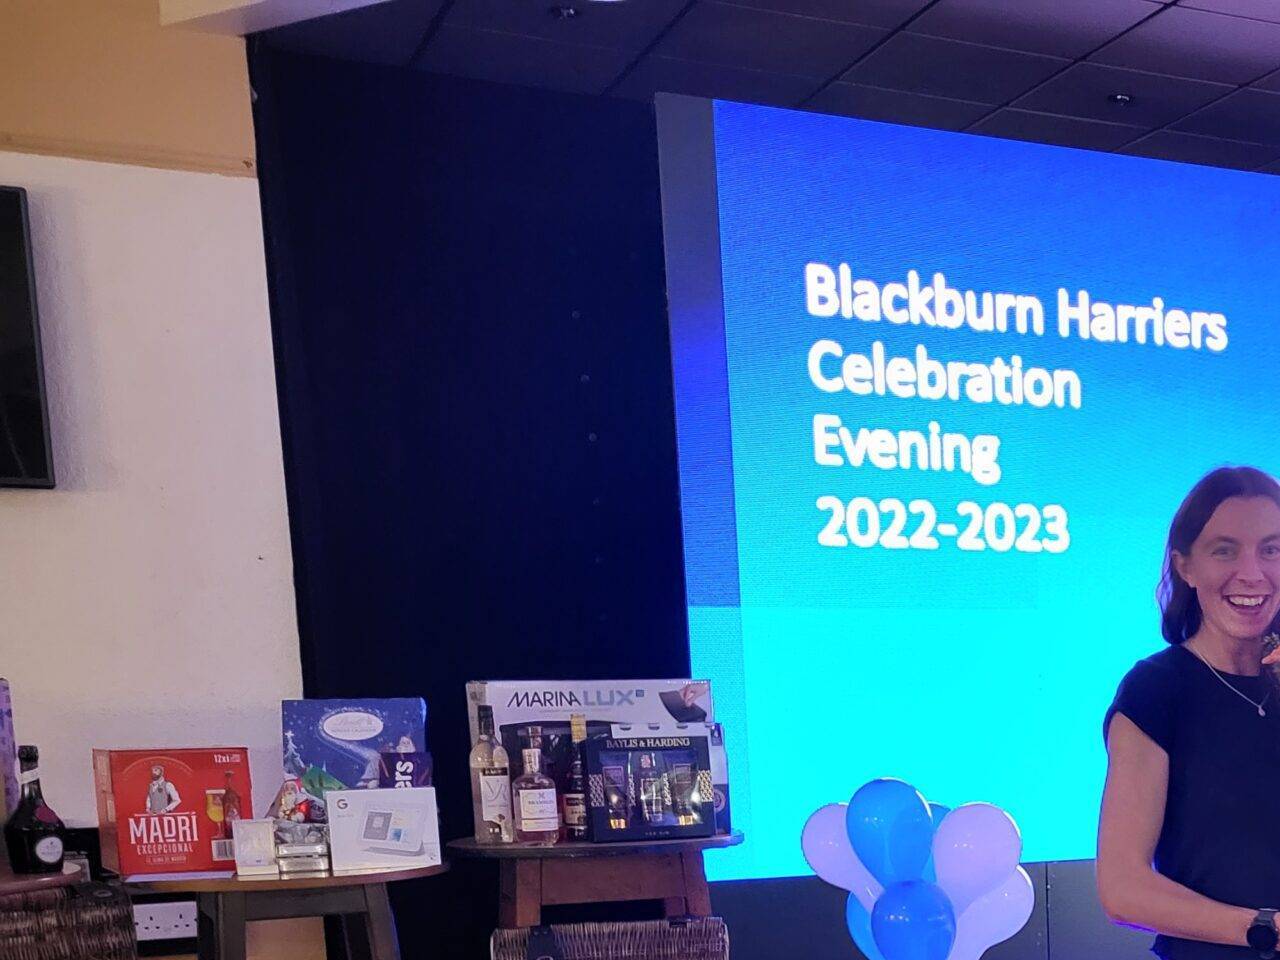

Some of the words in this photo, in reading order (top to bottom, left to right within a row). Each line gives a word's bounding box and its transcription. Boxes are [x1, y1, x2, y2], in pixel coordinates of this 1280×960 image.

[805, 262, 1044, 335] Blackburn
[1057, 288, 1228, 352] Harriers
[807, 340, 1082, 409] Celebration
[813, 414, 1001, 485] Evening
[816, 496, 1070, 554] 2022-2023
[647, 738, 690, 748] HARDING
[137, 842, 194, 855] EXCEPCIONAL
